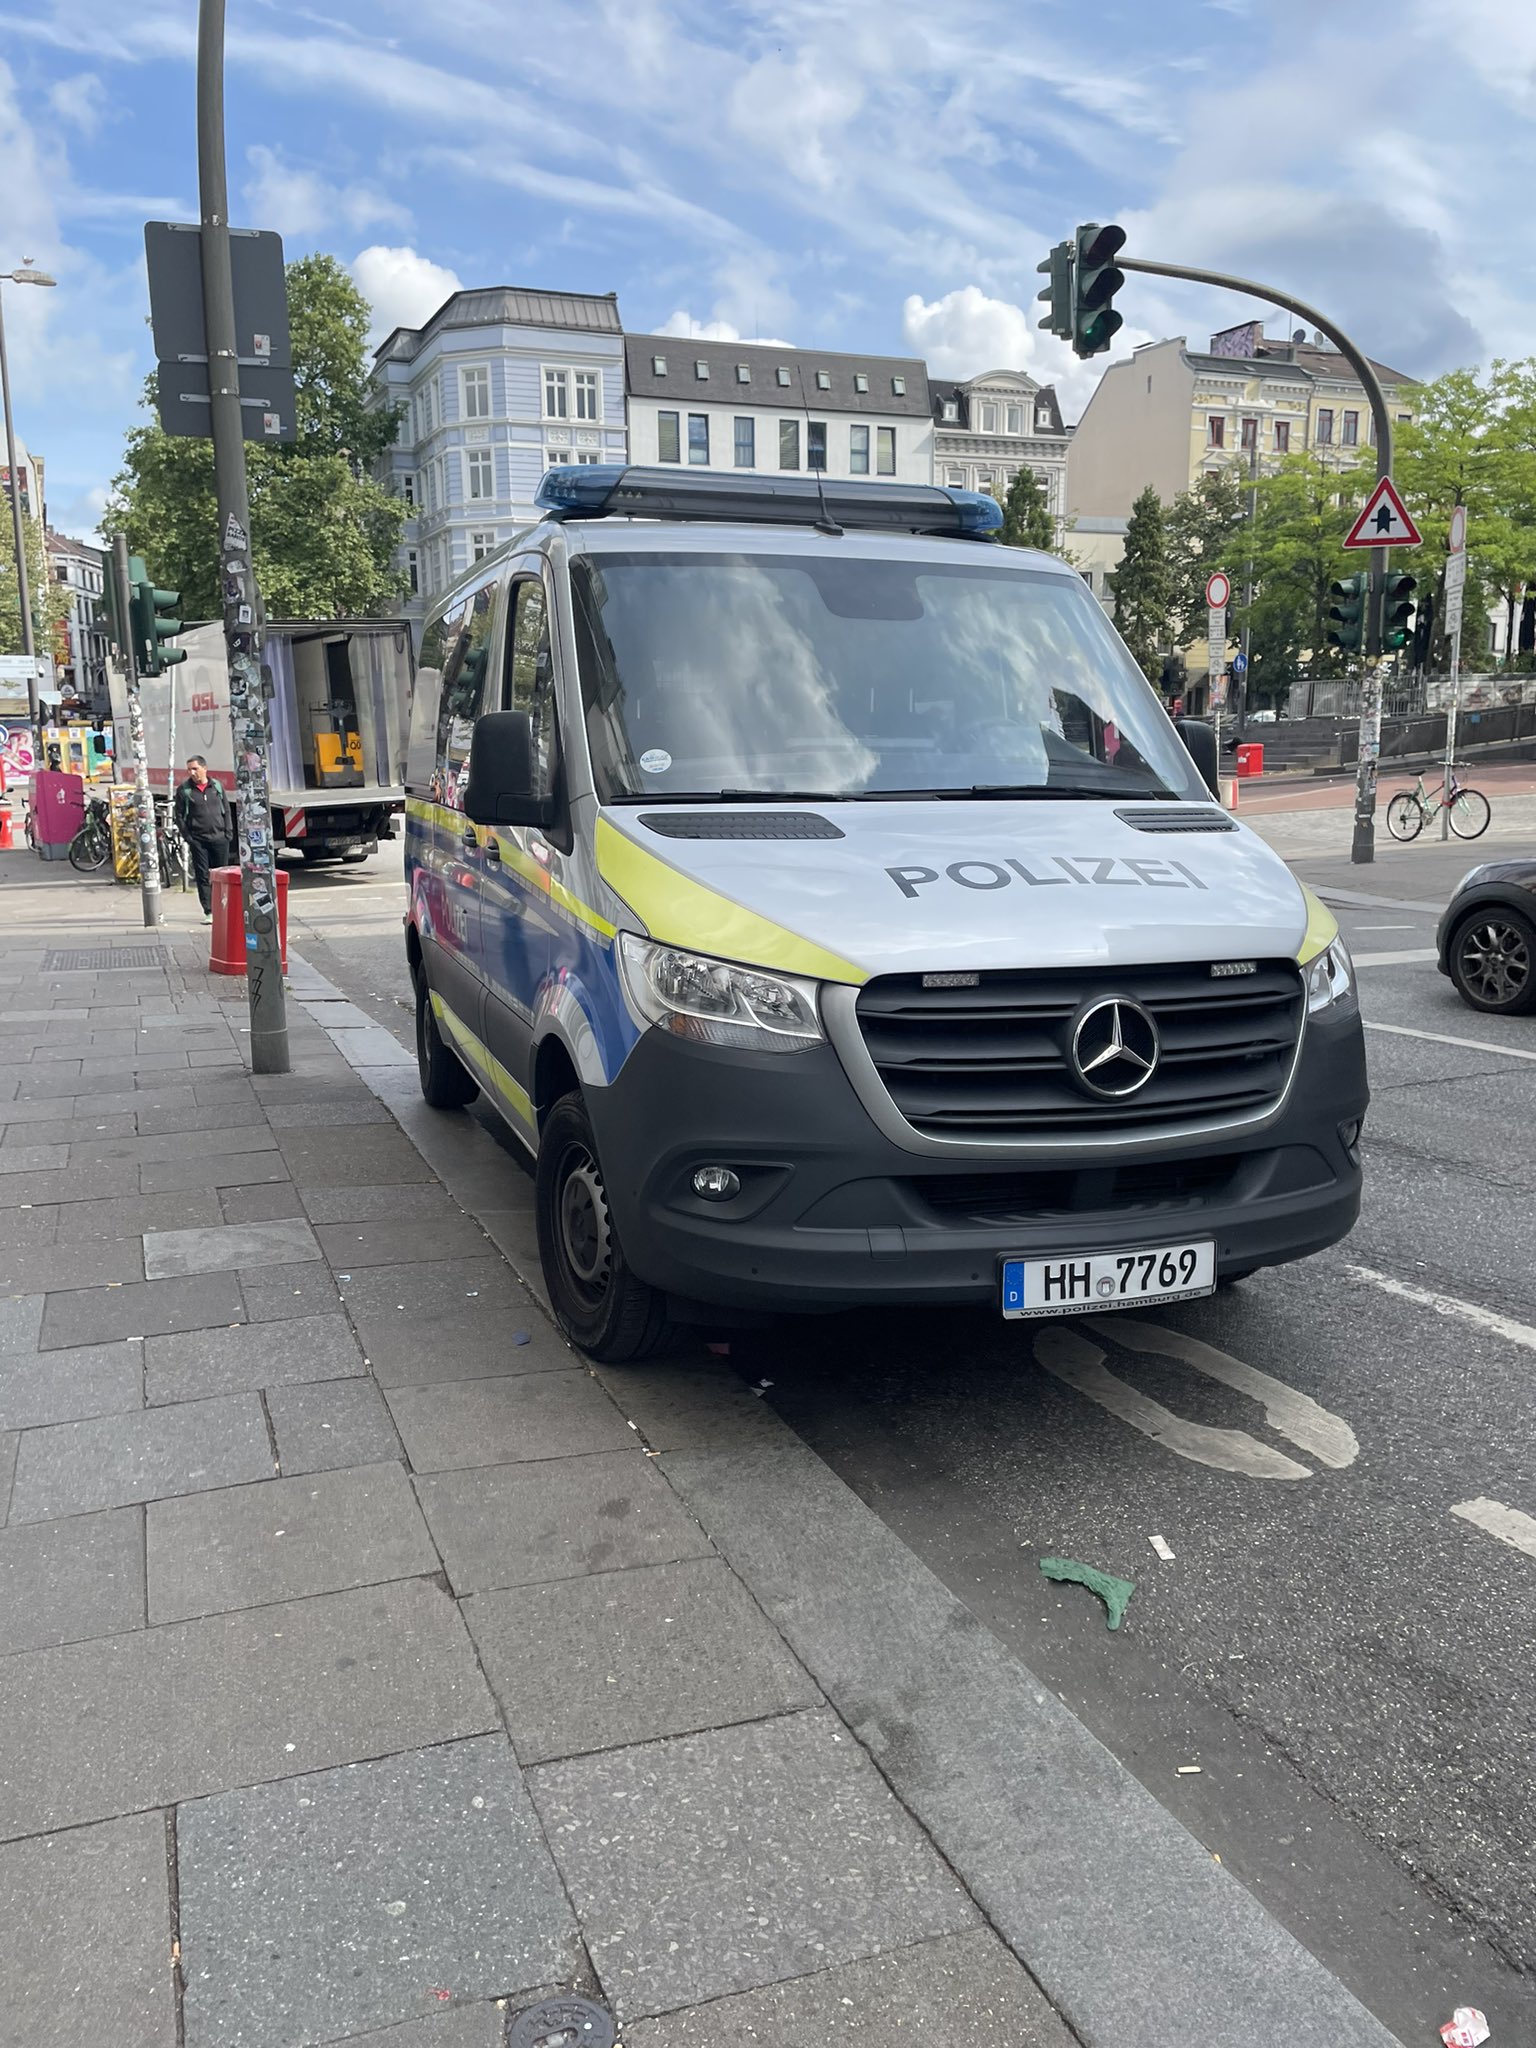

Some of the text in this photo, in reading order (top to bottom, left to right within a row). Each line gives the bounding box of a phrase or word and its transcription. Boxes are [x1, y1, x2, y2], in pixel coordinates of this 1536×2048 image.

[884, 856, 1210, 899] POLIZEI
[1044, 1249, 1198, 1302] HH 7769
[1009, 1291, 1018, 1303] D
[1019, 1289, 1202, 1317] www.polizei.hamburg.de
